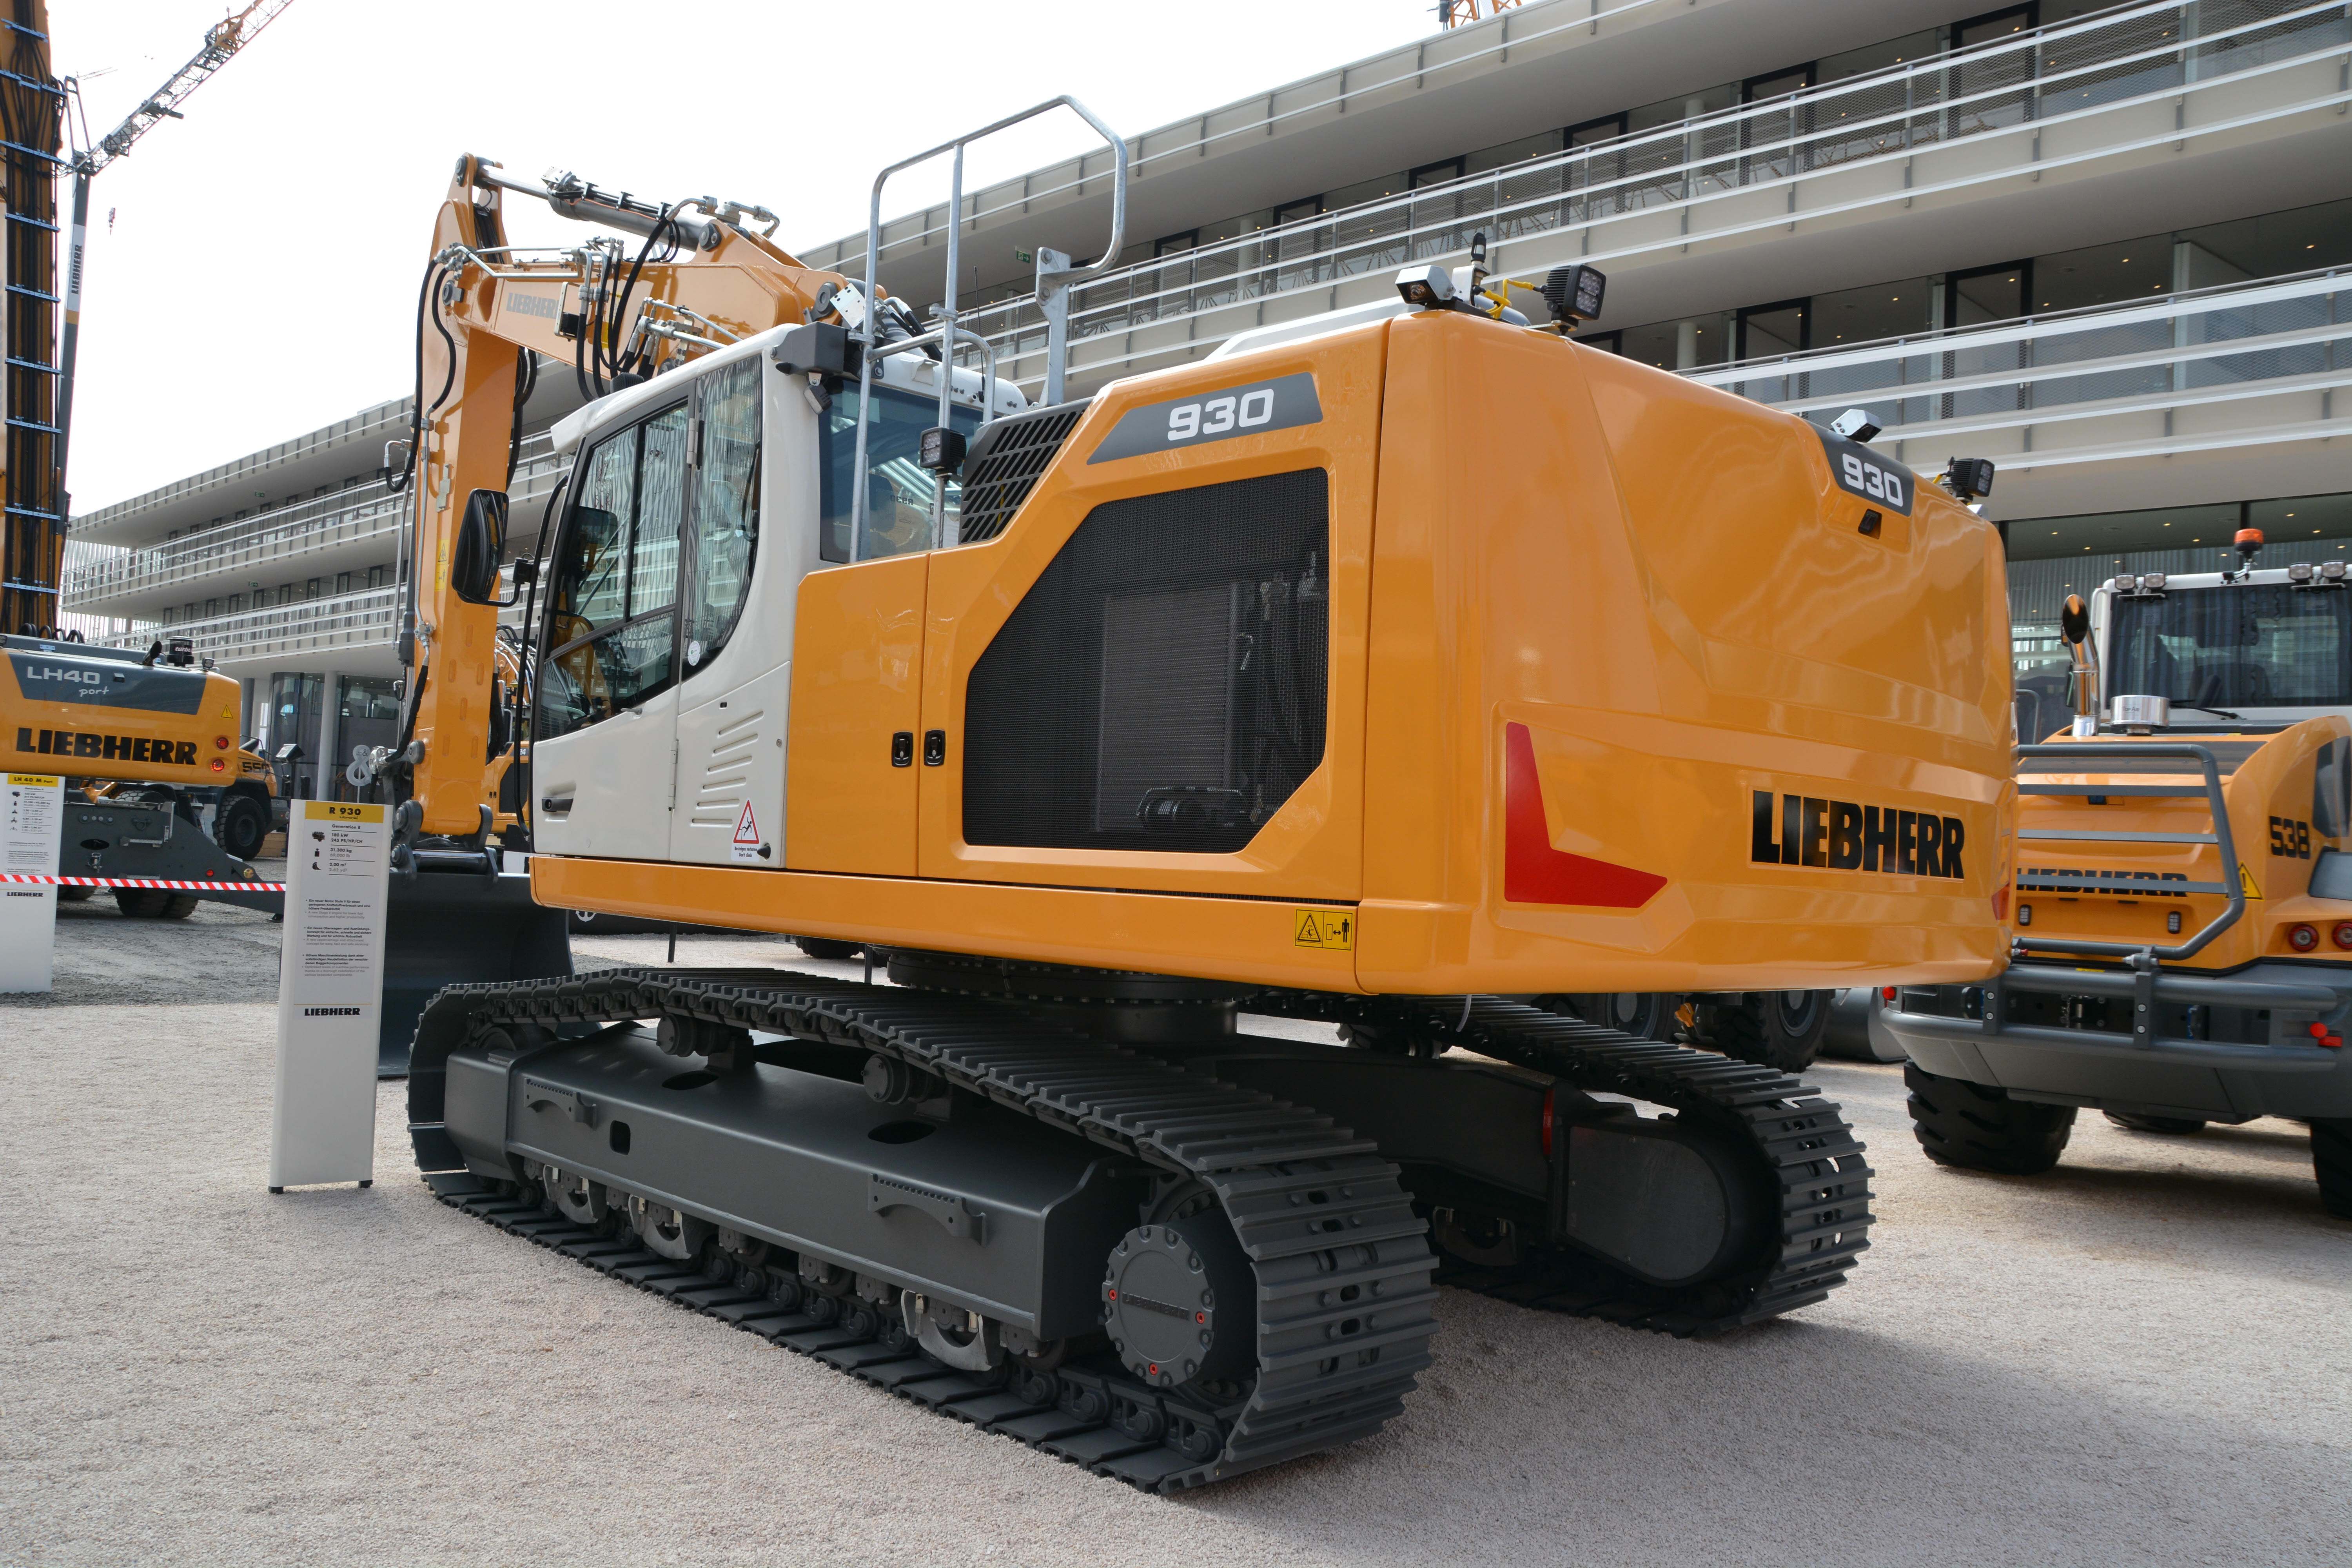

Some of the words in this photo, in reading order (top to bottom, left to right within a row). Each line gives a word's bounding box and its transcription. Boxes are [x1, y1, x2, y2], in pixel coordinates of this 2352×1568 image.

[71, 245, 82, 294] LIEBHERR
[506, 292, 559, 319] LIEBHER
[1167, 388, 1274, 441] 930
[1842, 453, 1904, 507] 930
[27, 666, 100, 684] LH40
[79, 686, 109, 697] port
[16, 727, 197, 765] LIEBHERR
[340, 807, 361, 815] 930
[1751, 790, 1965, 879] LIEBHERR
[2269, 815, 2311, 860] 538
[2017, 868, 2188, 897] IEBHERR
[304, 1007, 360, 1016] LIEBHERR
[1122, 1292, 1190, 1321] LIEBHERR
